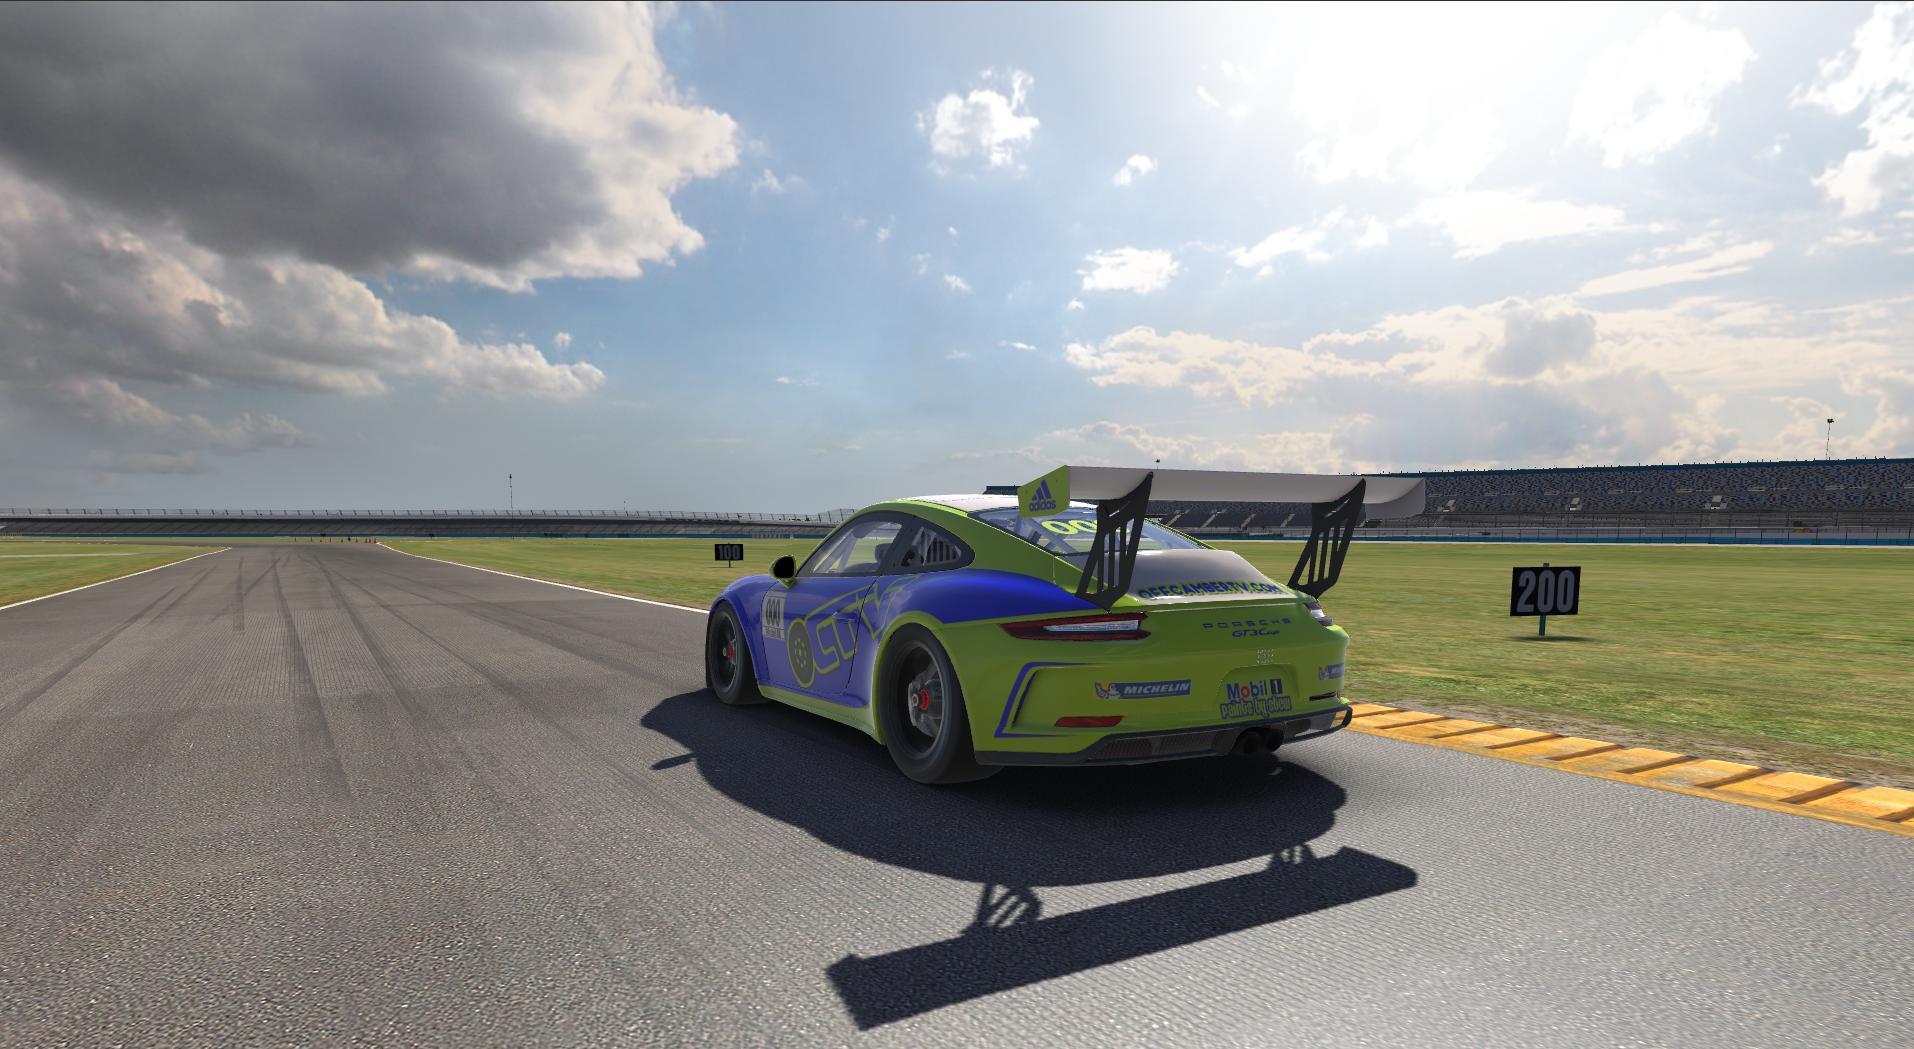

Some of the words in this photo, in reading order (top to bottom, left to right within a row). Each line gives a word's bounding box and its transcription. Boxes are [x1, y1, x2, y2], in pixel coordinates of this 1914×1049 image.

[1028, 500, 1057, 512] adidas
[718, 545, 741, 560] 100
[1516, 569, 1576, 613] 200
[1203, 618, 1291, 629] PORSCHE
[1124, 683, 1190, 695] MICHELIN
[1227, 680, 1267, 699] Mobil
